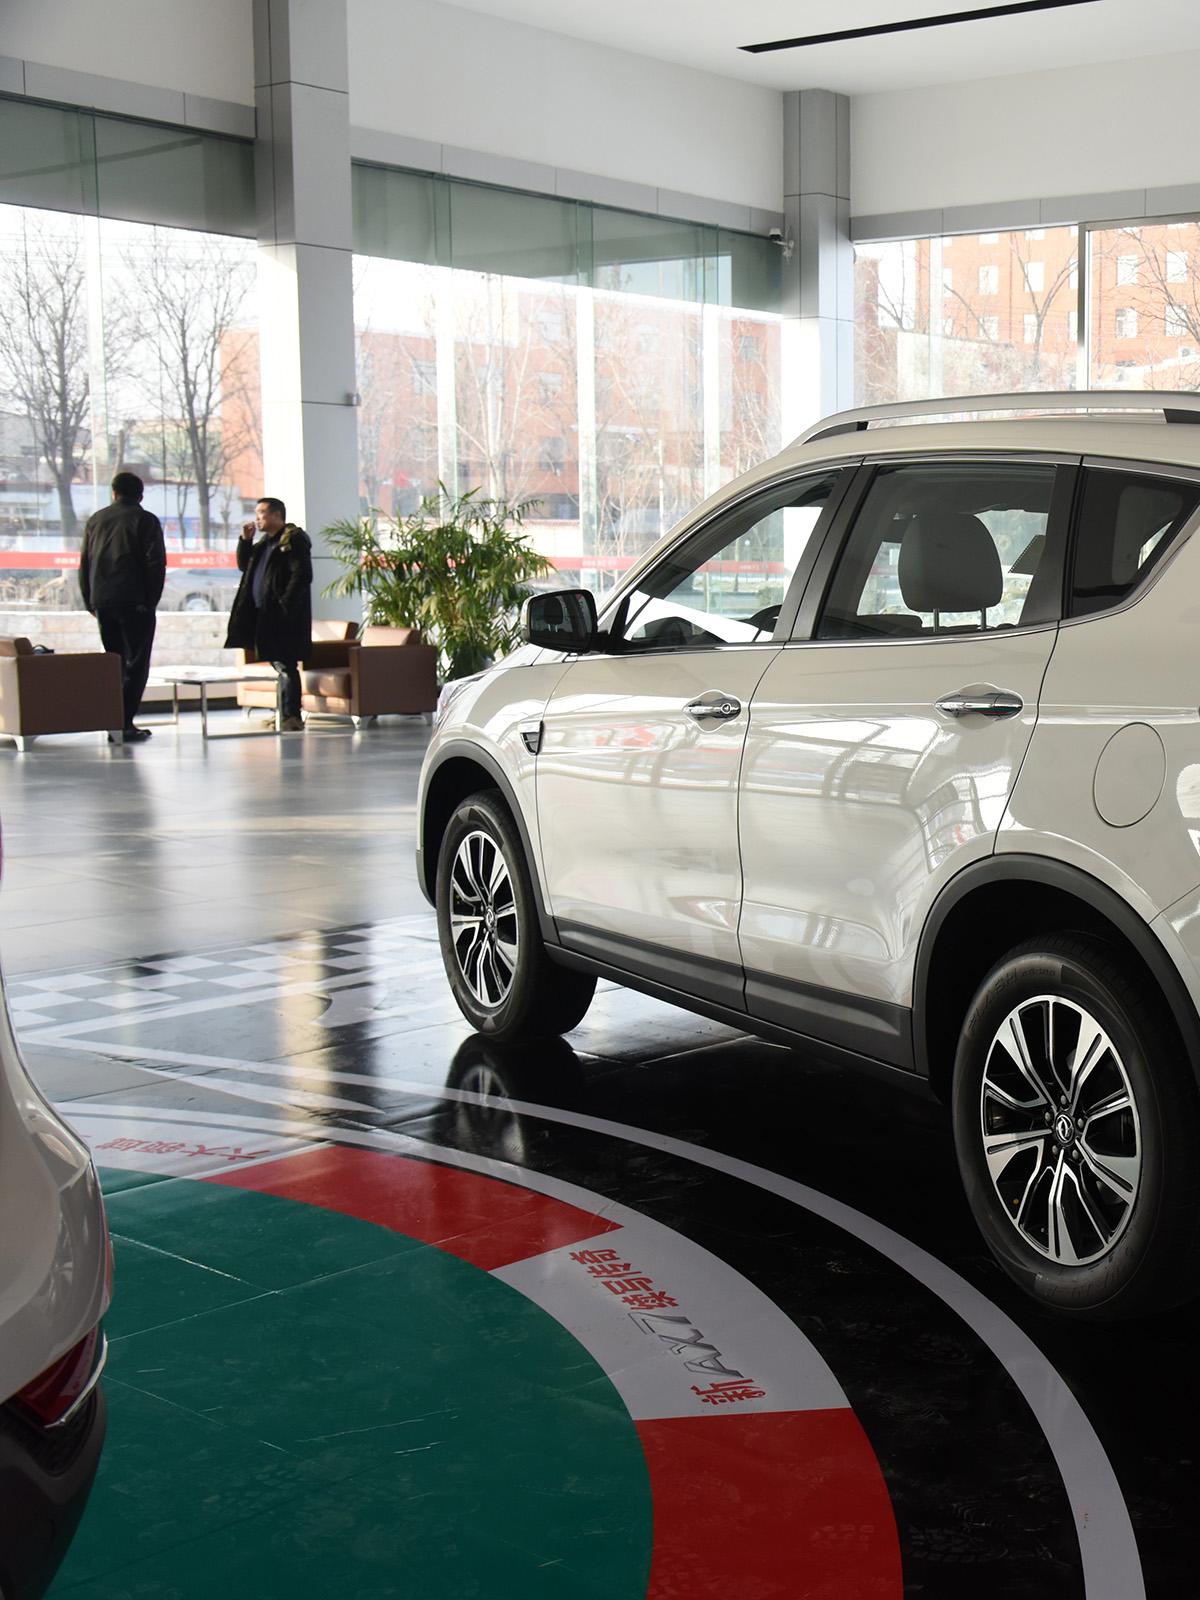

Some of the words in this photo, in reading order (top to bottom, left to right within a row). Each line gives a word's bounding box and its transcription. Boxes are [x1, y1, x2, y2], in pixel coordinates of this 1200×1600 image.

[569, 1249, 679, 1310] 续写传奇
[627, 1311, 744, 1378] AX7
[690, 1378, 766, 1405] 新
